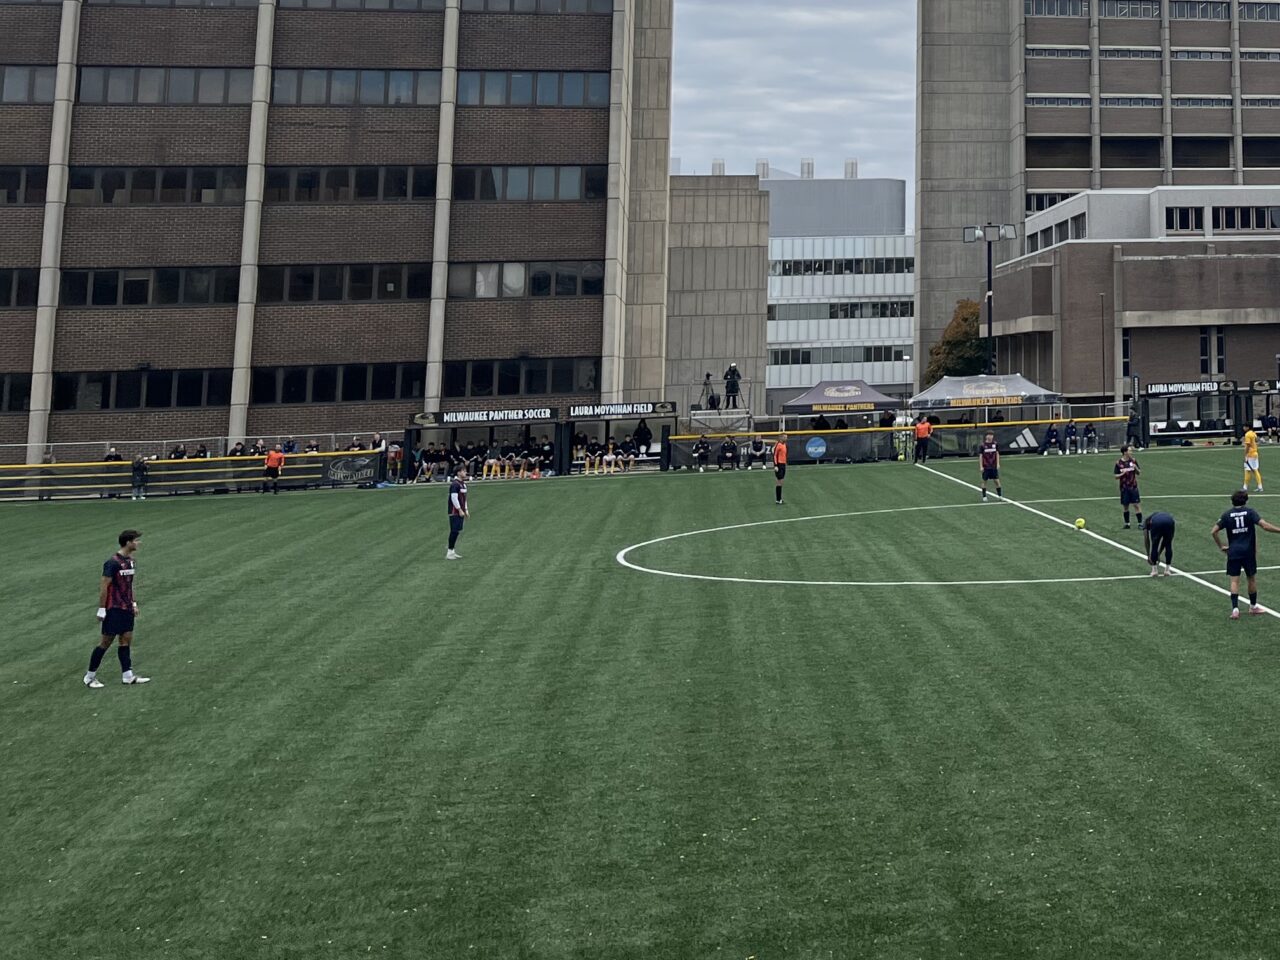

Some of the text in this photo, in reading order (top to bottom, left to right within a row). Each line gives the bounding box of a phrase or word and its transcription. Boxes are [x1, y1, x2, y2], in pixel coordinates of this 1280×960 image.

[1148, 382, 1218, 393] LAURA MOYNIHAN FIELD
[950, 396, 1022, 406] MILWAUKEE ATHLETICS
[570, 404, 653, 416] LAURA MOYNIHAN FIELD
[812, 403, 845, 411] MILWAUKEE
[444, 409, 551, 422] MILWAUKEE PANTHER SOCCER
[1234, 516, 1245, 528] 11
